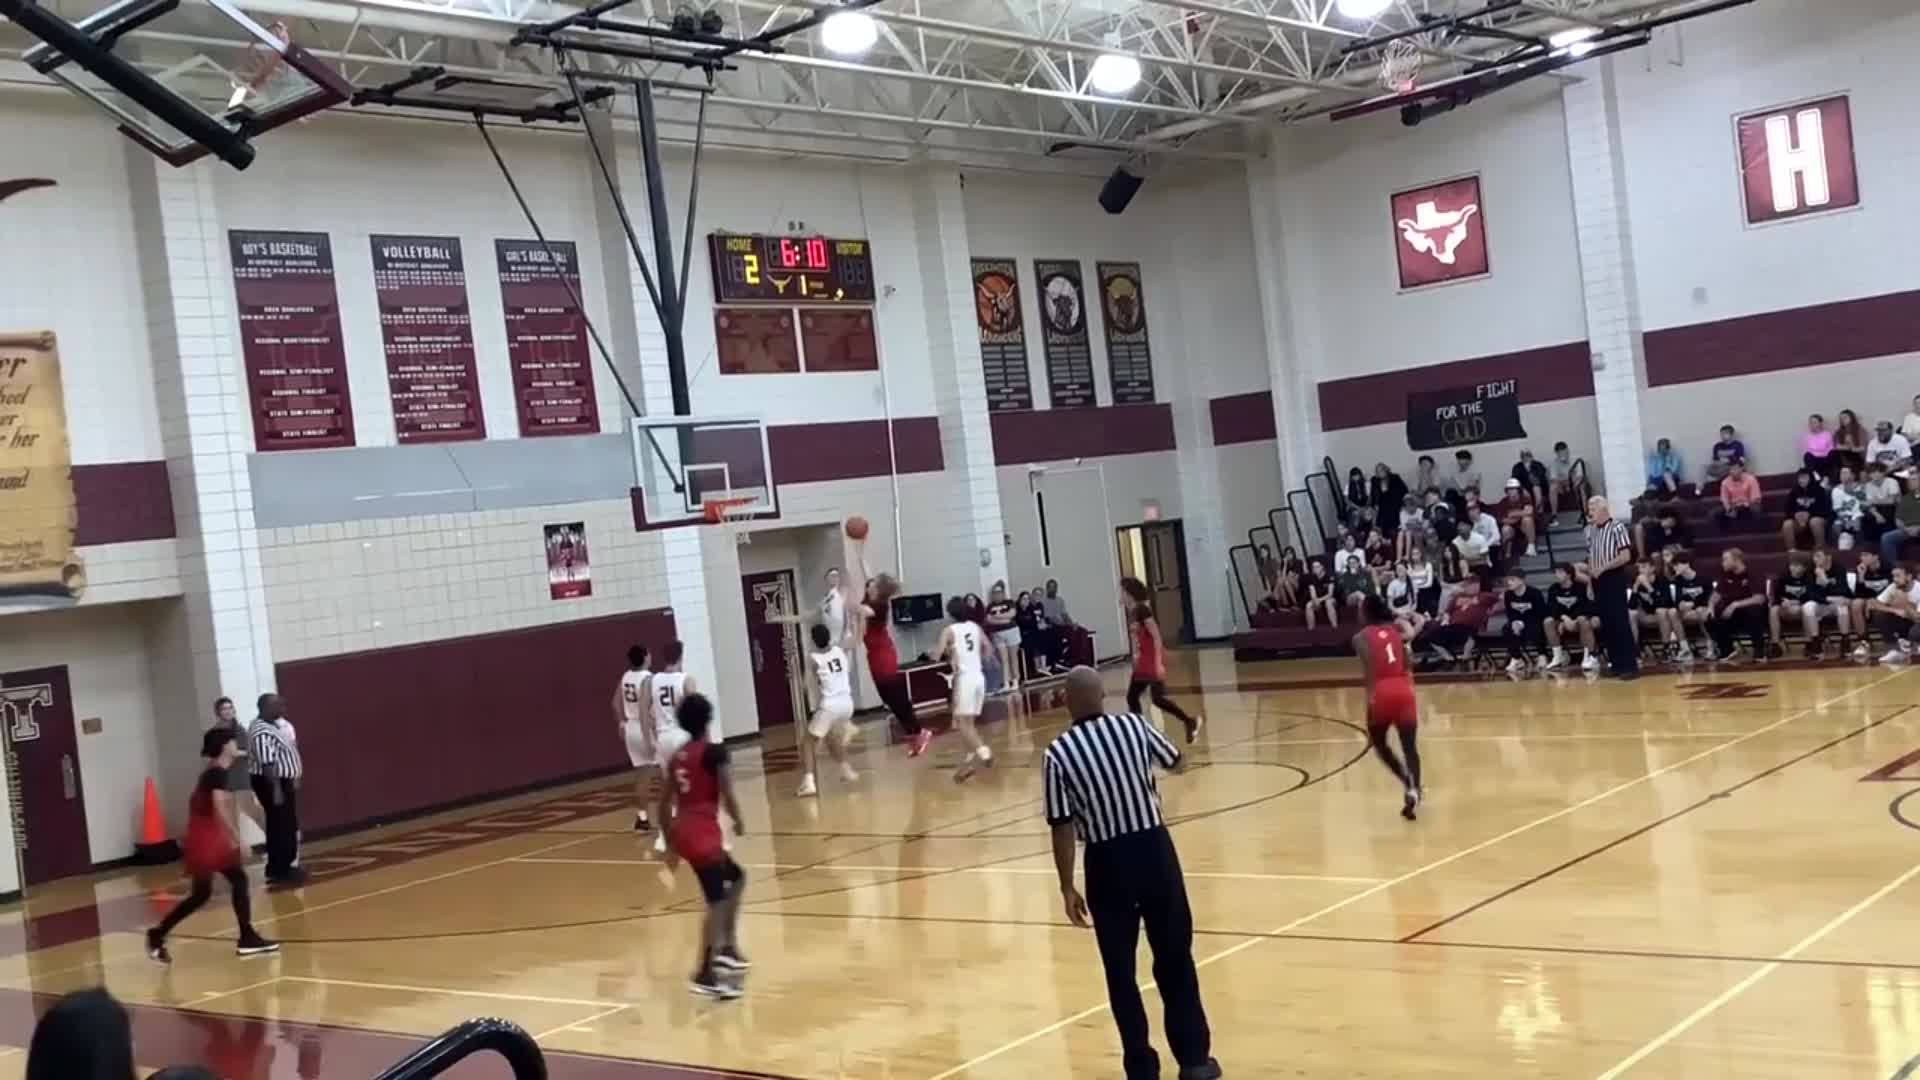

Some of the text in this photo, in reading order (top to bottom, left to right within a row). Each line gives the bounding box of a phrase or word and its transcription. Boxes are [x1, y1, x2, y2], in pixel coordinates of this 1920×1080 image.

[1765, 108, 1830, 212] H
[269, 243, 318, 256] BASKETBALL
[382, 246, 451, 259] VOLLEYBALL
[726, 238, 752, 251] HOME
[780, 239, 826, 268] 6:10
[743, 254, 760, 284] 2
[1476, 380, 1516, 399] FIGHT
[1436, 401, 1483, 420] FOR THE
[1441, 416, 1487, 443] GOLD
[964, 633, 974, 652] 5
[1385, 643, 1397, 664] 1
[827, 658, 842, 673] 13
[659, 685, 675, 706] 21
